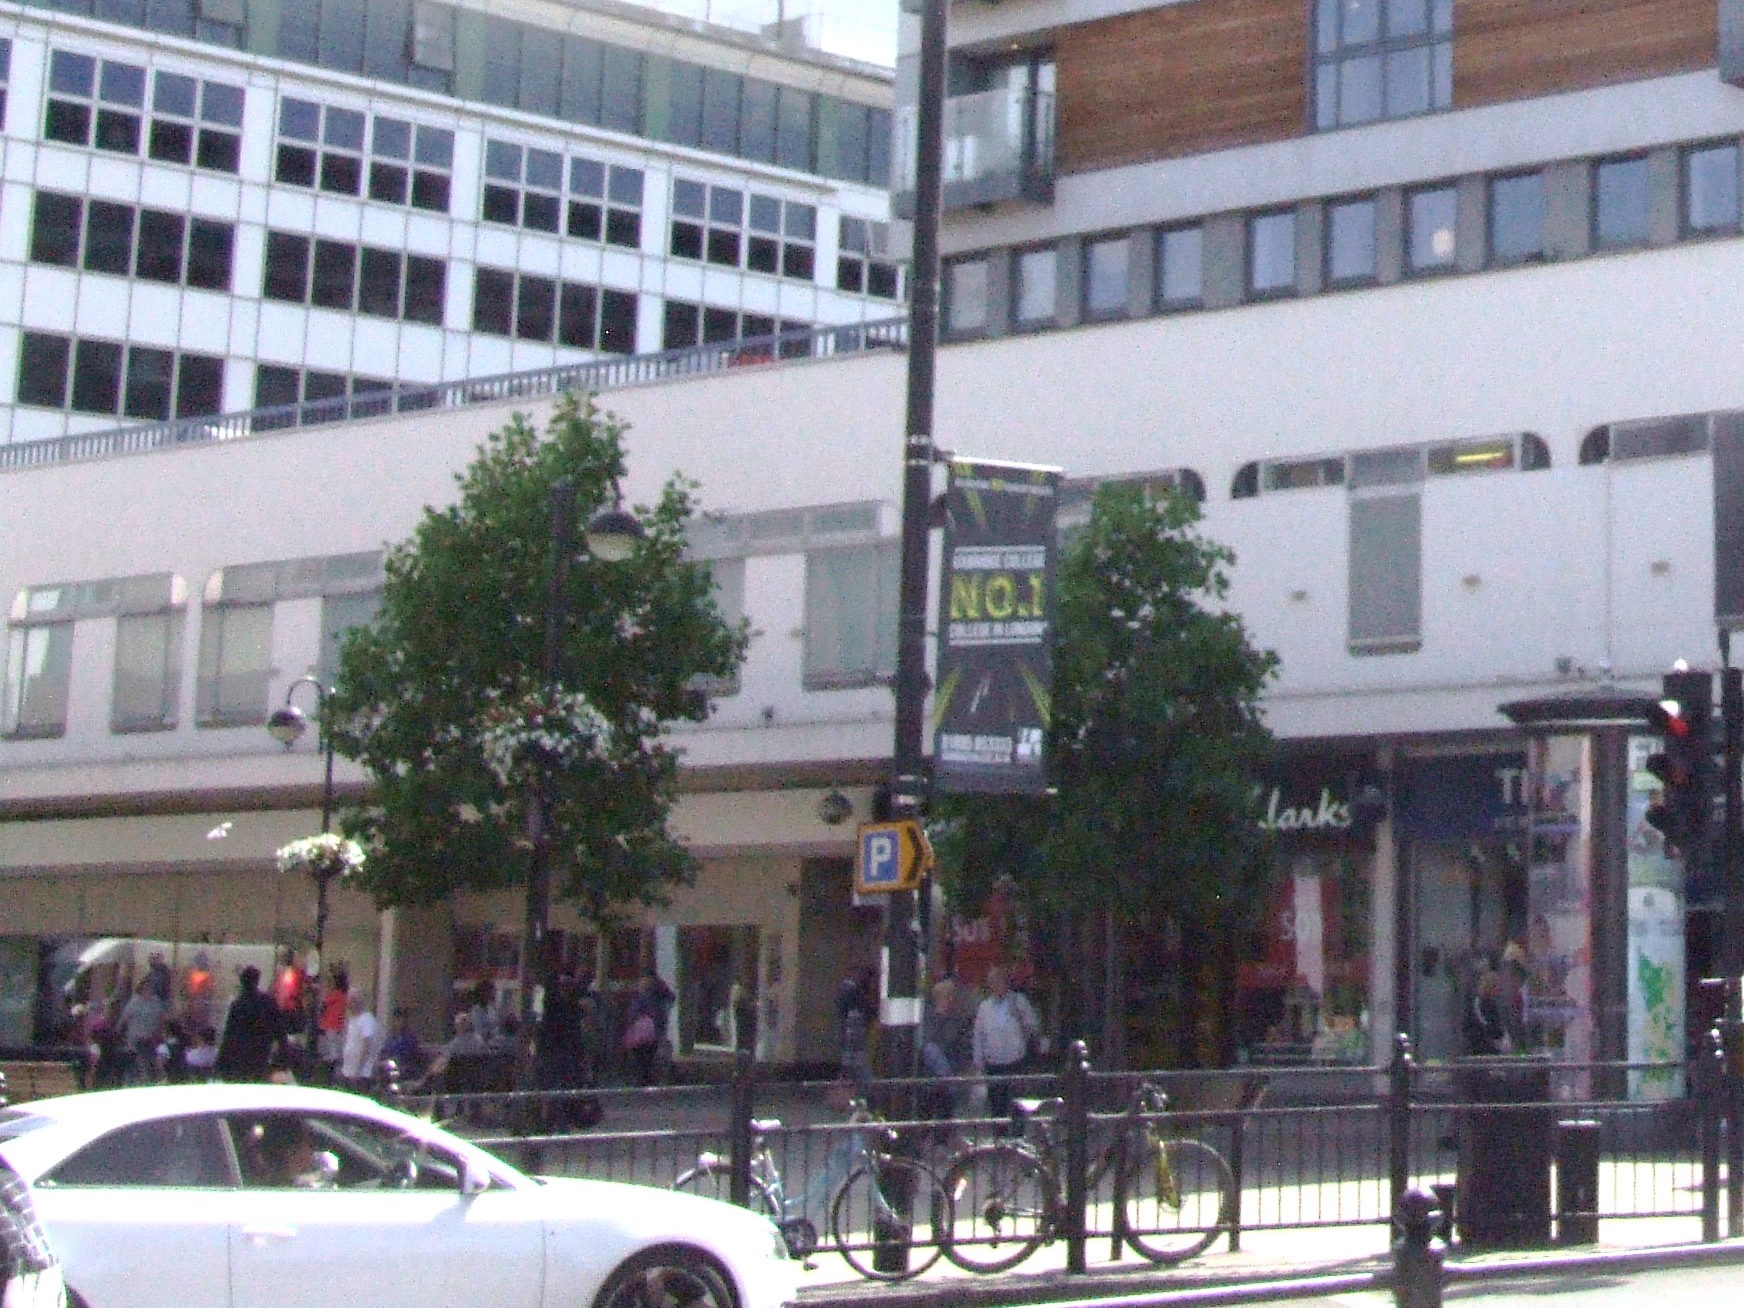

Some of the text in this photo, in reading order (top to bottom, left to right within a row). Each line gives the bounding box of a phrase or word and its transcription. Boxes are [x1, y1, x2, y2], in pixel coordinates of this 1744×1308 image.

[950, 573, 1046, 620] NO.1
[1253, 785, 1352, 831] larks
[870, 836, 893, 878] P
